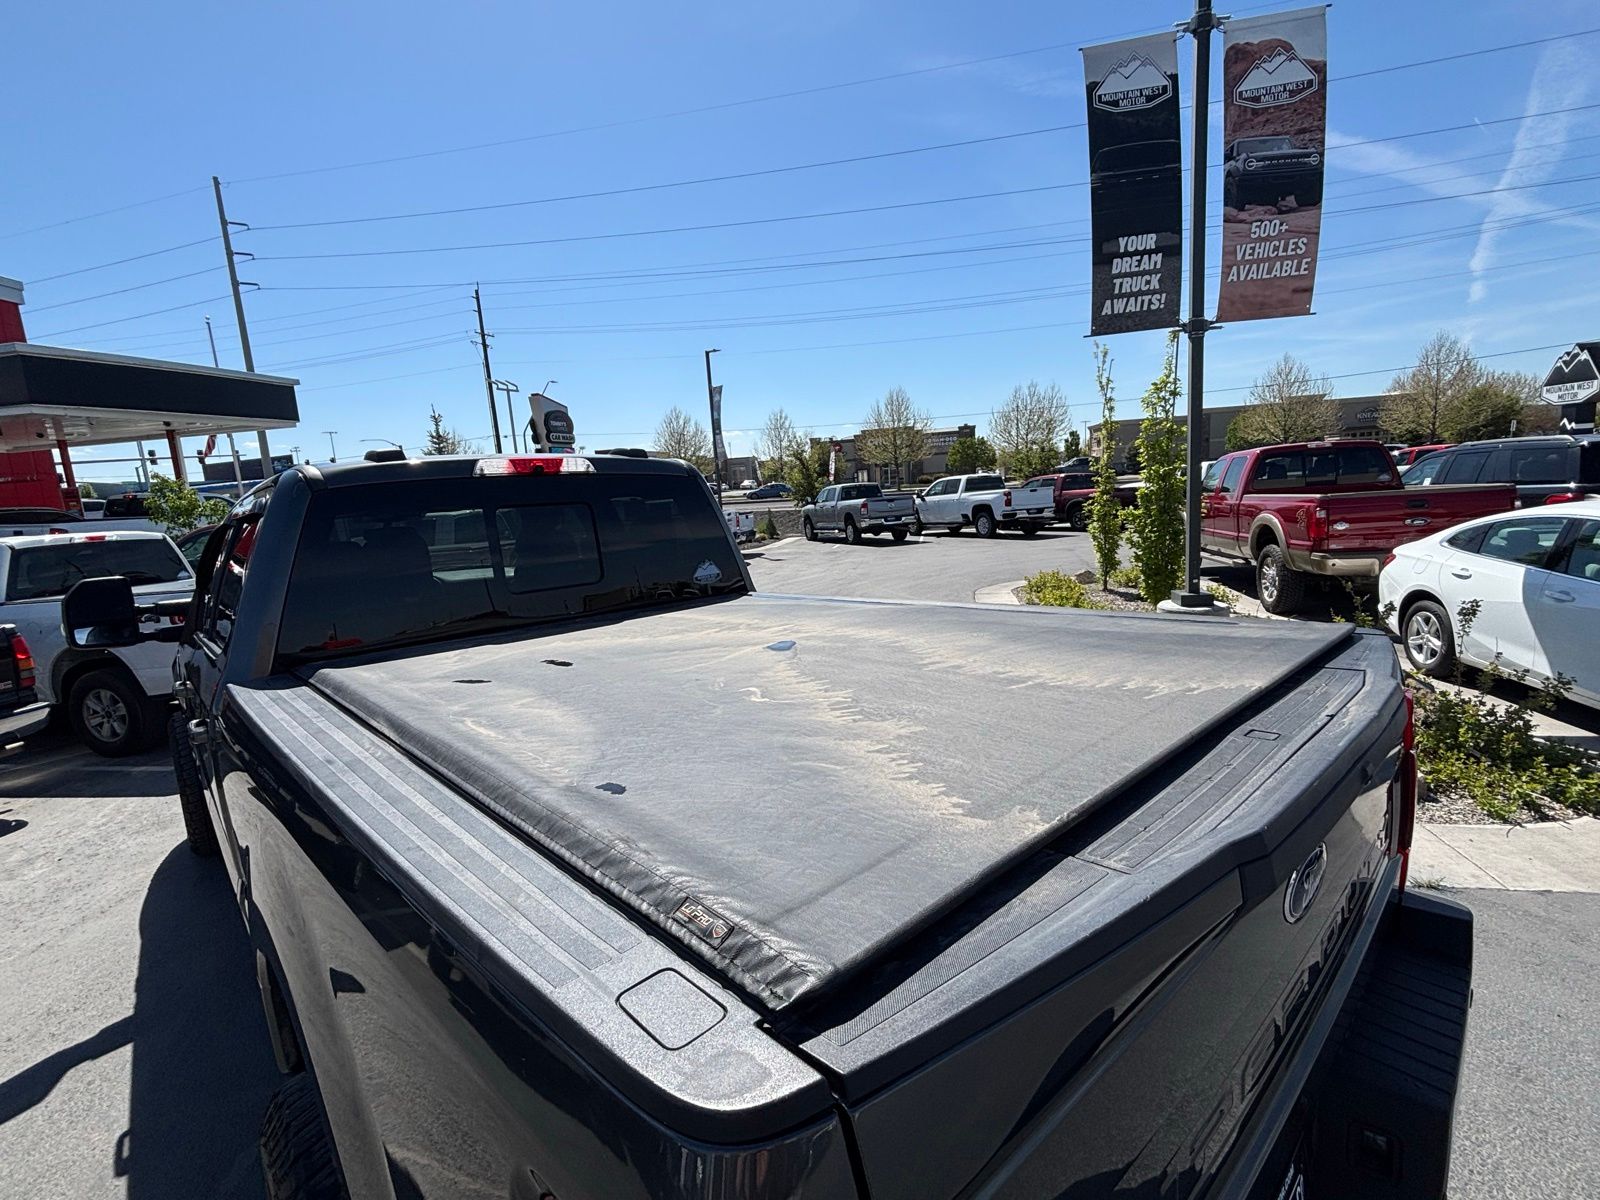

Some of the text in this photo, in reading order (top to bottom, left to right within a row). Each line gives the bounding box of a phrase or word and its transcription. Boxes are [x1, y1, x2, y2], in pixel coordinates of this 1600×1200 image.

[1101, 86, 1163, 102] MOUNTAIN WEST
[1242, 81, 1308, 99] MOUNTAIN WEST
[1261, 91, 1290, 103] MOTOR
[1119, 96, 1146, 107] MOTOR
[1250, 219, 1289, 239] 500+
[1118, 233, 1157, 253] YOUR
[1236, 237, 1308, 261] VEHICLES
[1111, 252, 1163, 274] DREAM
[1227, 257, 1312, 282] AVAILABLE
[1113, 273, 1162, 294] TRUCK
[1101, 292, 1167, 316] AWAITS!
[1545, 381, 1594, 394] MOUNTAIN WEST
[1557, 391, 1579, 400] MOTOR
